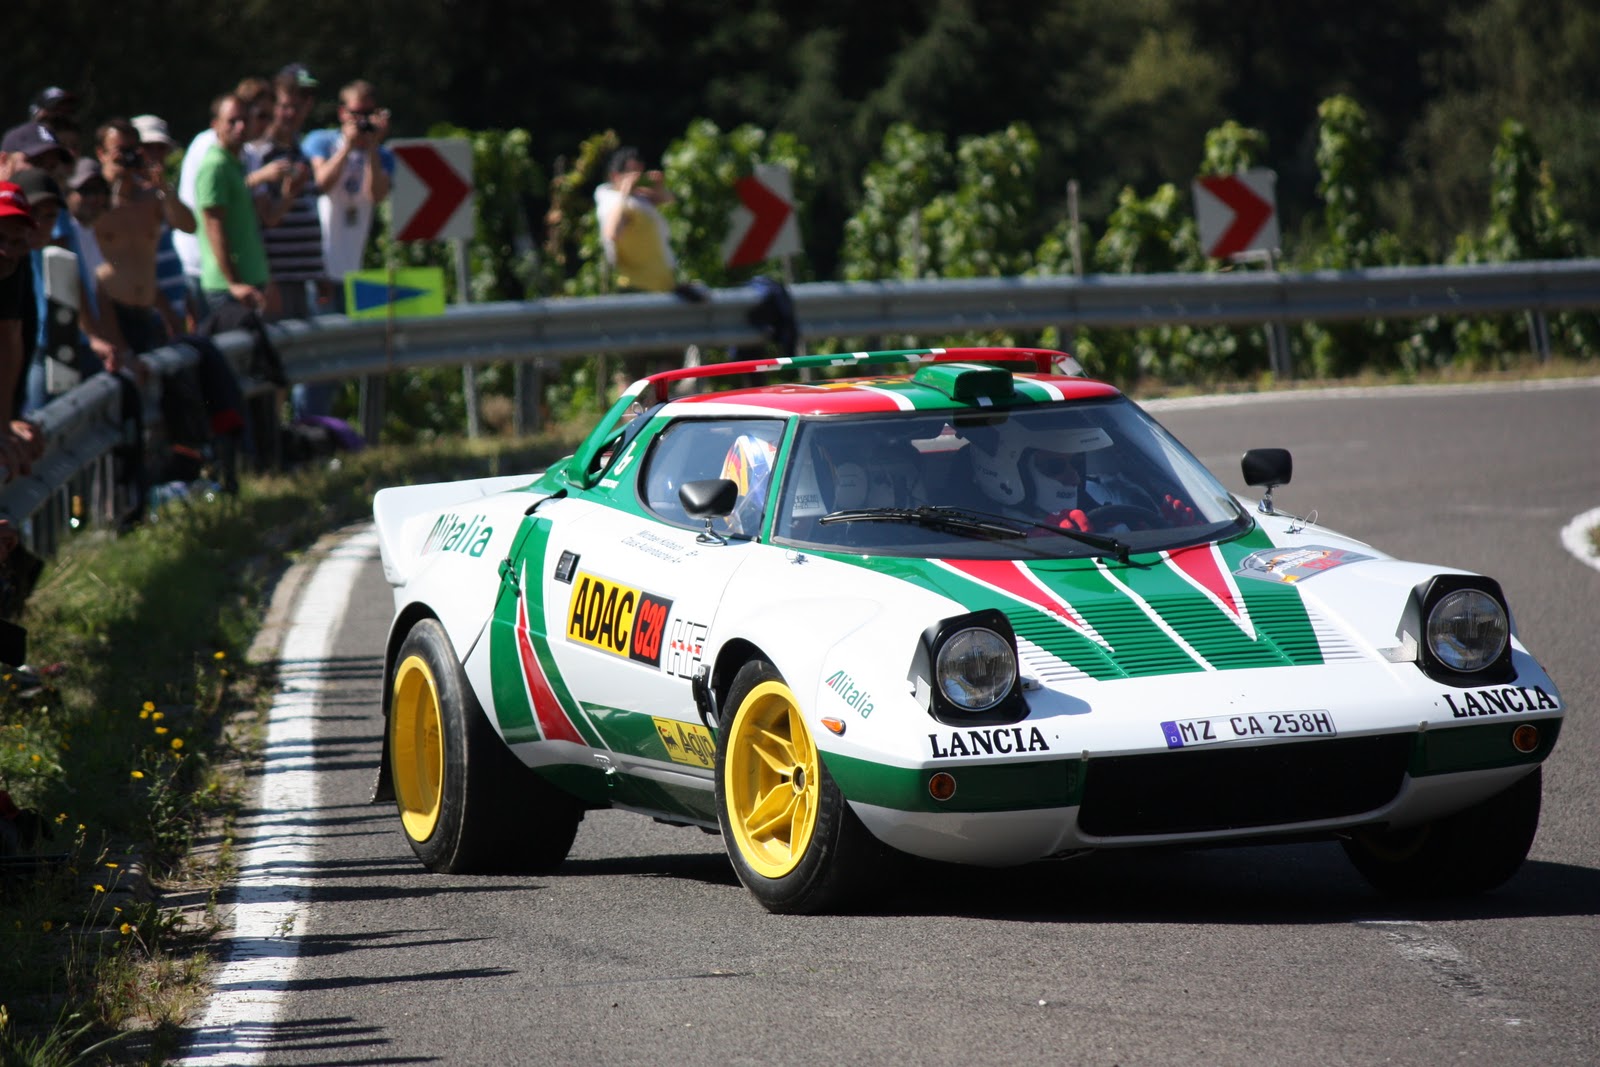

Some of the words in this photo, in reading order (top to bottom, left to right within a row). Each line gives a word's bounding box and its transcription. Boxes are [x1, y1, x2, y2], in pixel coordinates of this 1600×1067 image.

[420, 513, 493, 557] Alitalia
[570, 577, 634, 652] ADAC
[634, 599, 667, 660] C28
[667, 618, 709, 680] HF
[825, 670, 874, 719] Alitalia
[1442, 685, 1558, 718] LANCIA
[928, 727, 1049, 758] LANCIA
[1179, 720, 1216, 742] MZ
[1230, 716, 1264, 736] CA
[1269, 713, 1332, 733] 258H
